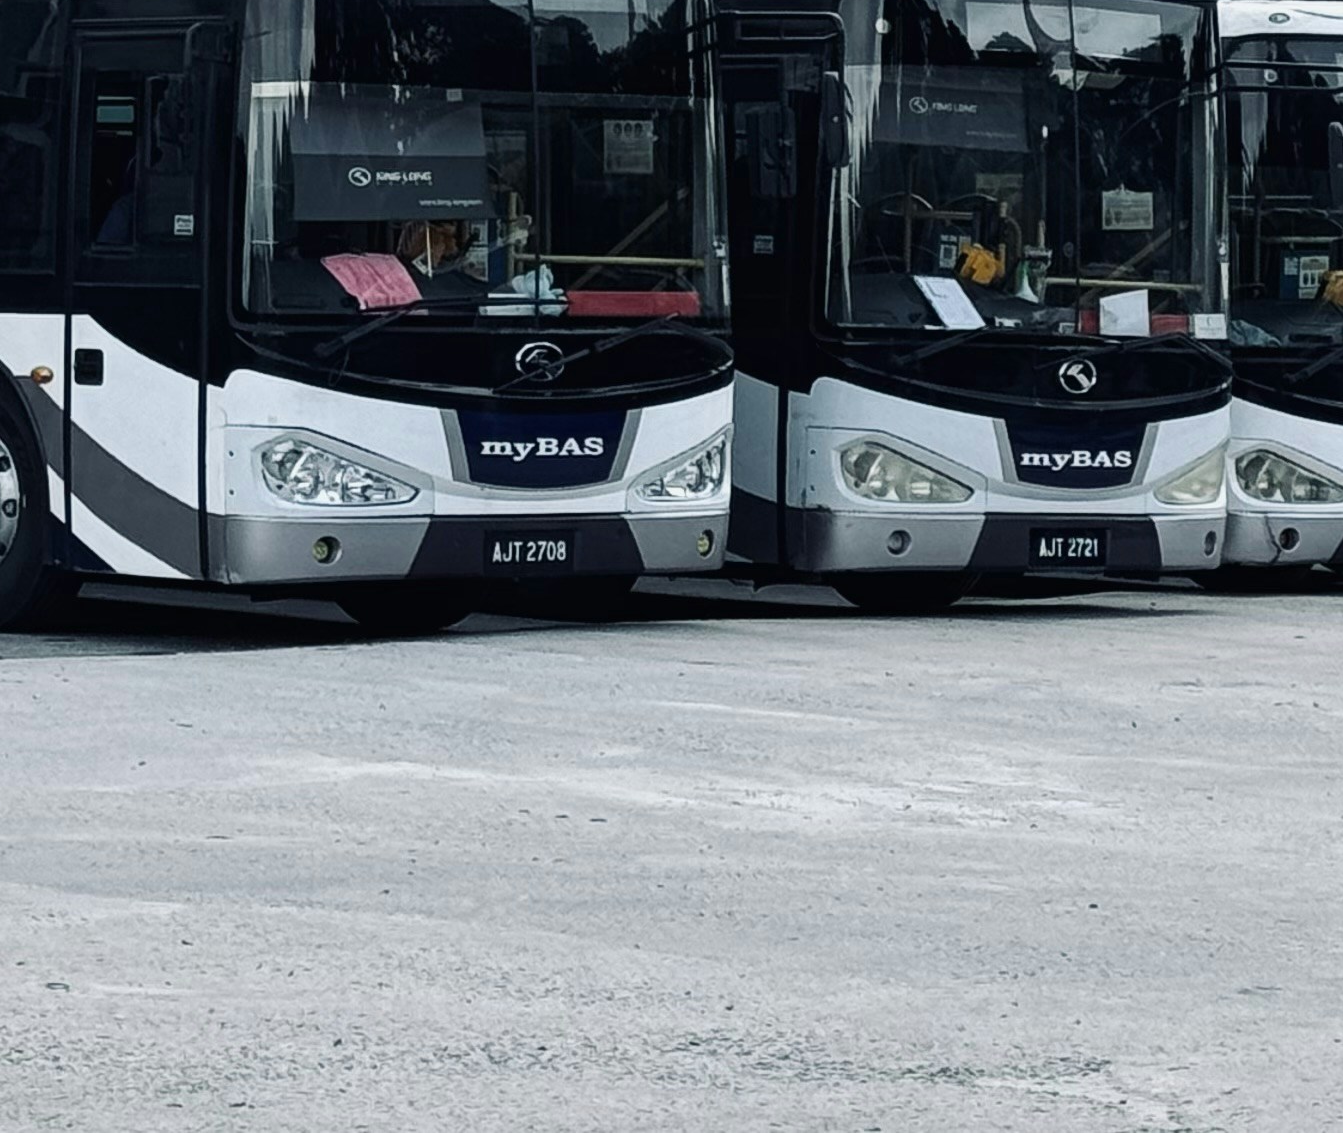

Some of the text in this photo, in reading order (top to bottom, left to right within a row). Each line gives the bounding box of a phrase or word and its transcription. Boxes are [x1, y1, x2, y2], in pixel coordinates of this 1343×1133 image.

[480, 437, 604, 462] myBAS
[1020, 450, 1132, 471] myBAS
[492, 540, 566, 562] AJT 2708
[1039, 537, 1098, 558] AJT 2721
